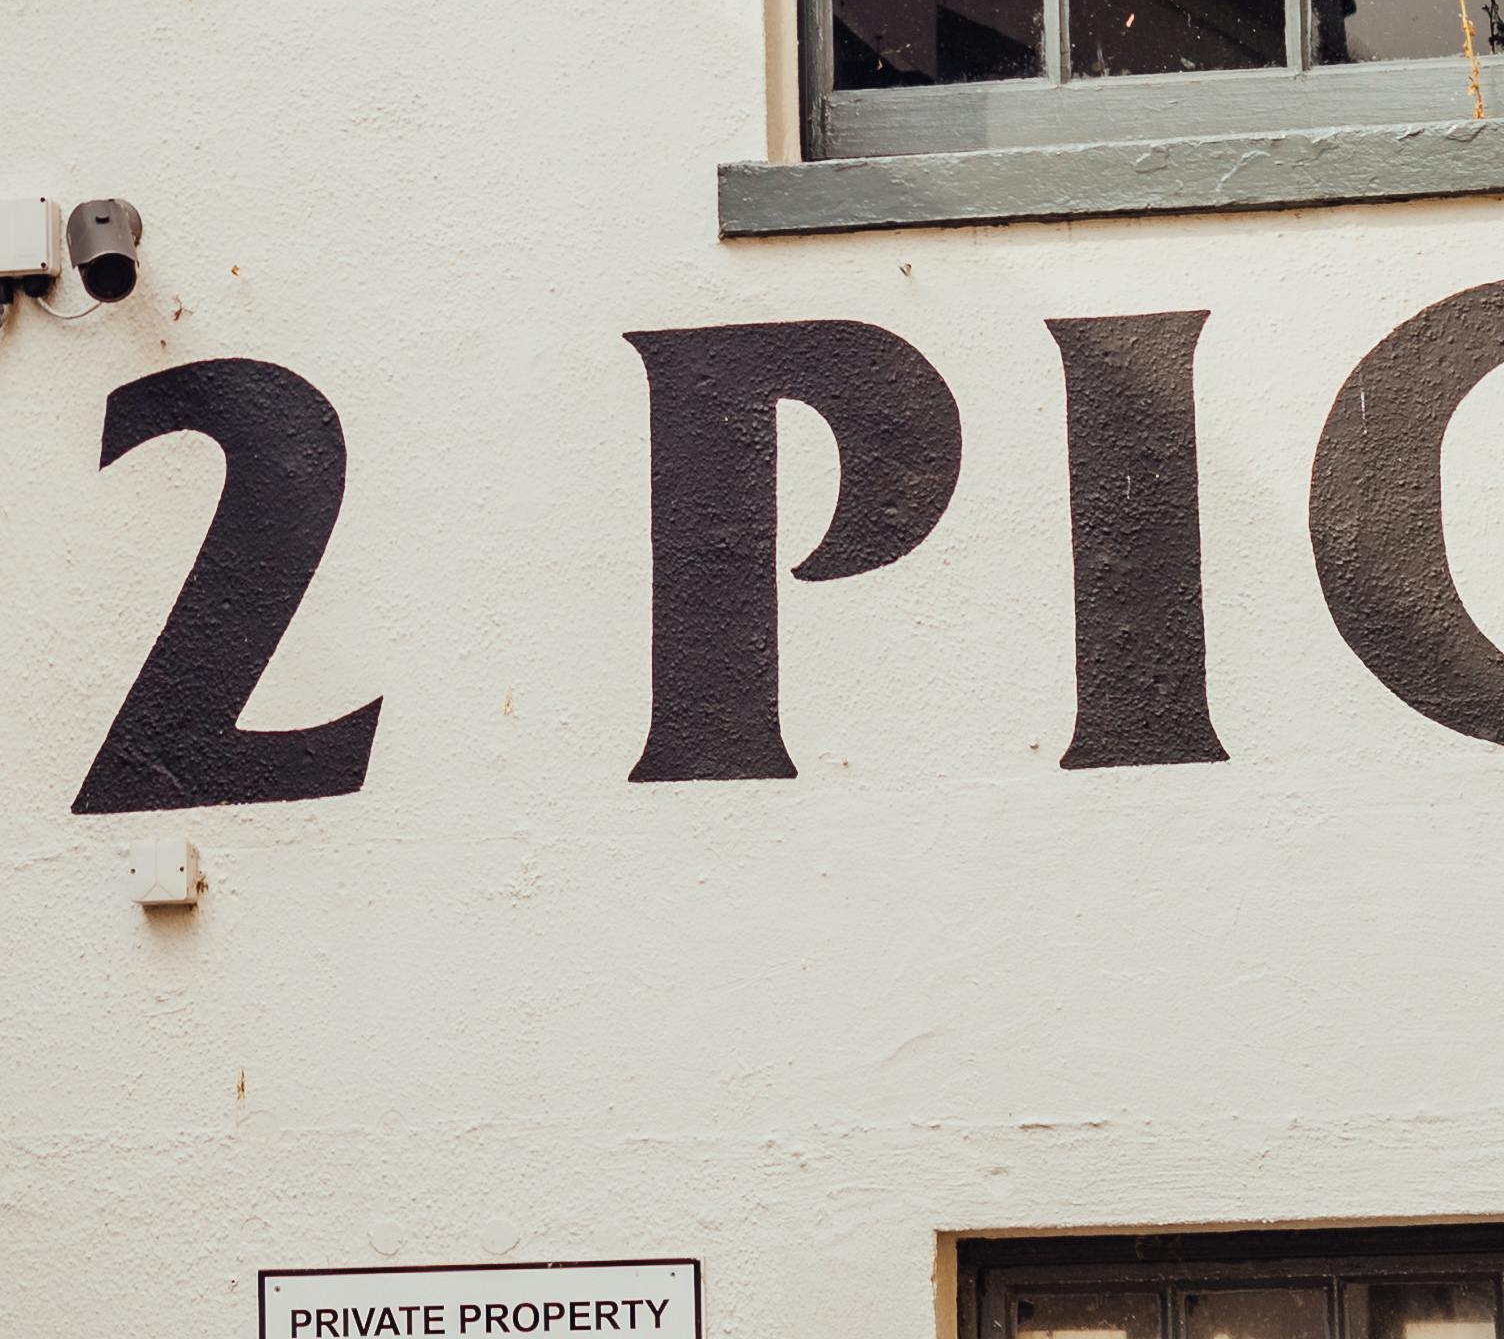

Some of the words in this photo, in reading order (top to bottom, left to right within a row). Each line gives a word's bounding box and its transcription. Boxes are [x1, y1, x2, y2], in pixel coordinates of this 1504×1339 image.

[71, 357, 383, 815] 2
[291, 1305, 446, 1339] PRIVATE
[459, 1299, 670, 1334] PROPERTY
